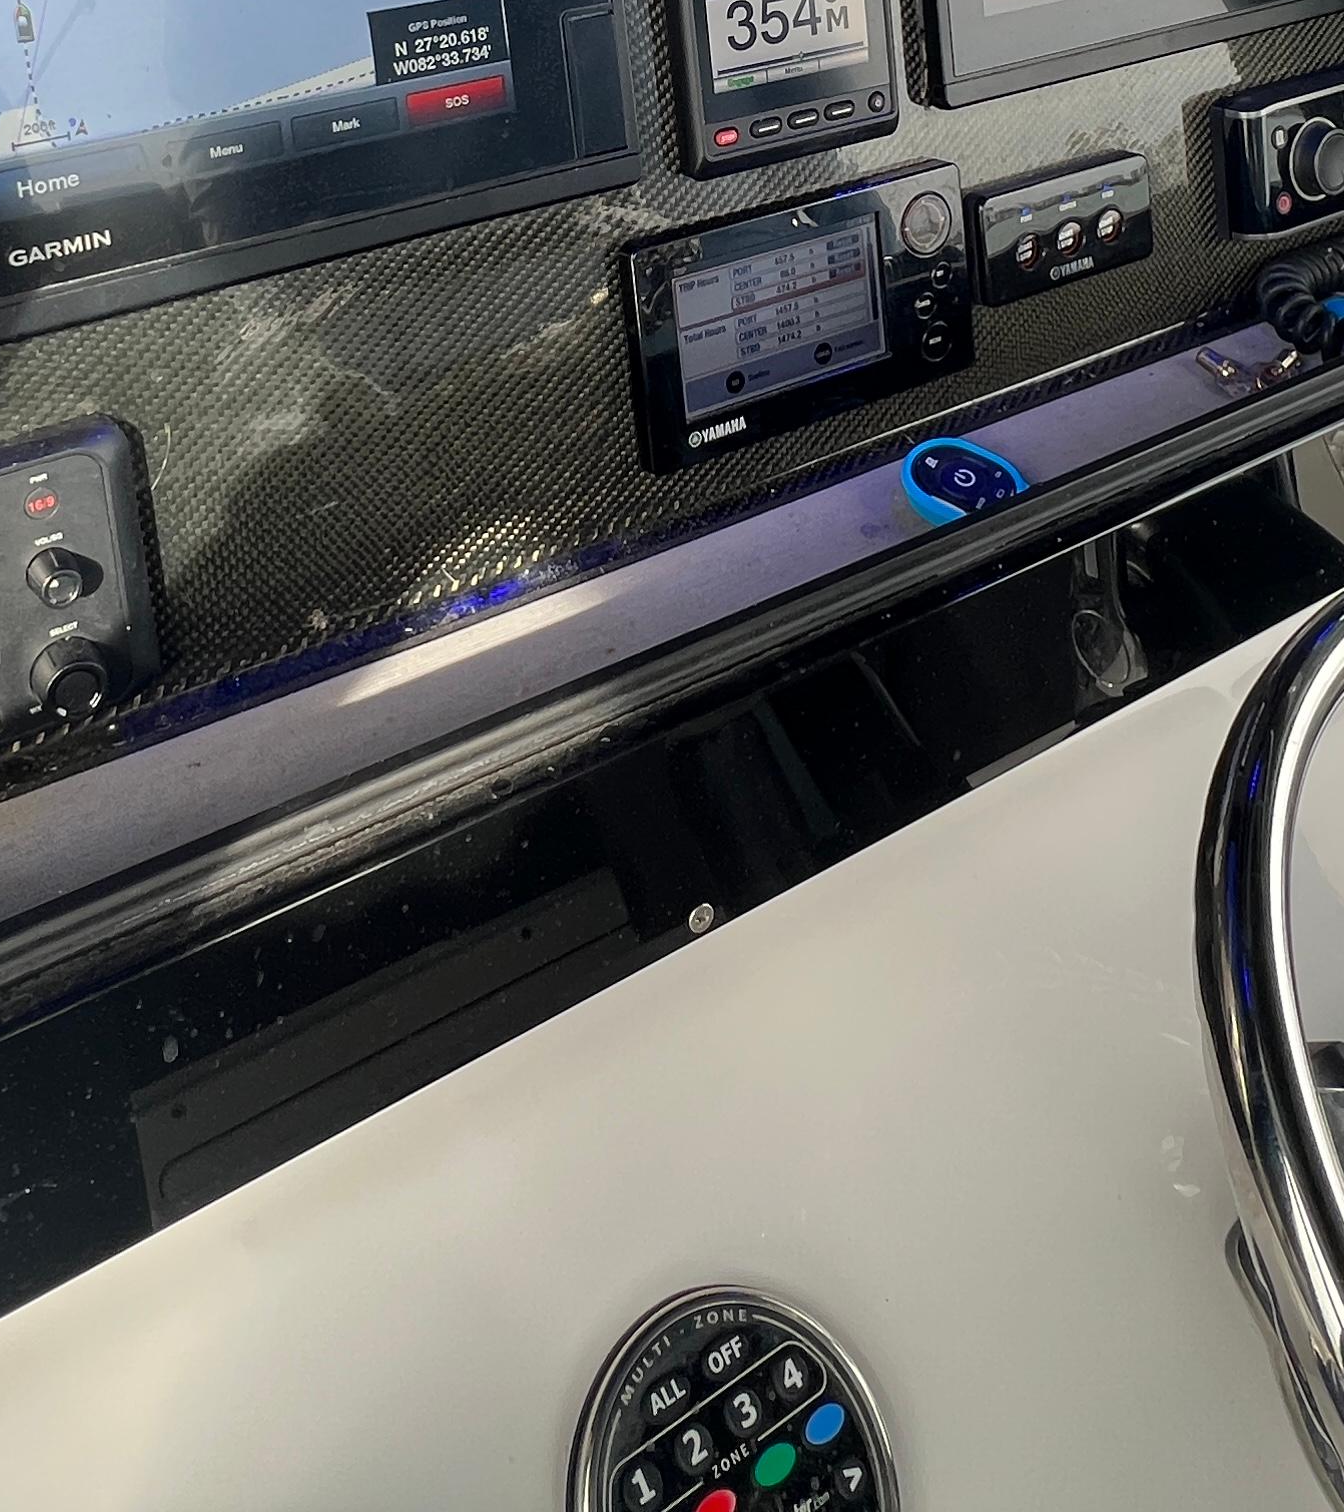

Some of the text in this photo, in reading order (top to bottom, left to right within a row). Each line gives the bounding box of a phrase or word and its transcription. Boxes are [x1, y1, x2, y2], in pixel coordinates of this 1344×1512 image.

[408, 15, 468, 33] GPS Position
[395, 41, 408, 57] N
[16, 170, 80, 199] Home
[209, 141, 244, 159] Menu
[332, 115, 361, 133] Mark
[445, 94, 470, 108] SOS
[7, 229, 113, 268] GARMIN
[1060, 256, 1095, 277] YAMAHA
[702, 416, 747, 443] YAMAHA
[49, 620, 78, 638] SELECT
[693, 1308, 748, 1330] ZONE
[649, 1335, 744, 1417] ALL OFF
[631, 1357, 804, 1505] 1 2 3 4
[711, 1443, 750, 1480] ZONE
[843, 1466, 863, 1492] 7
